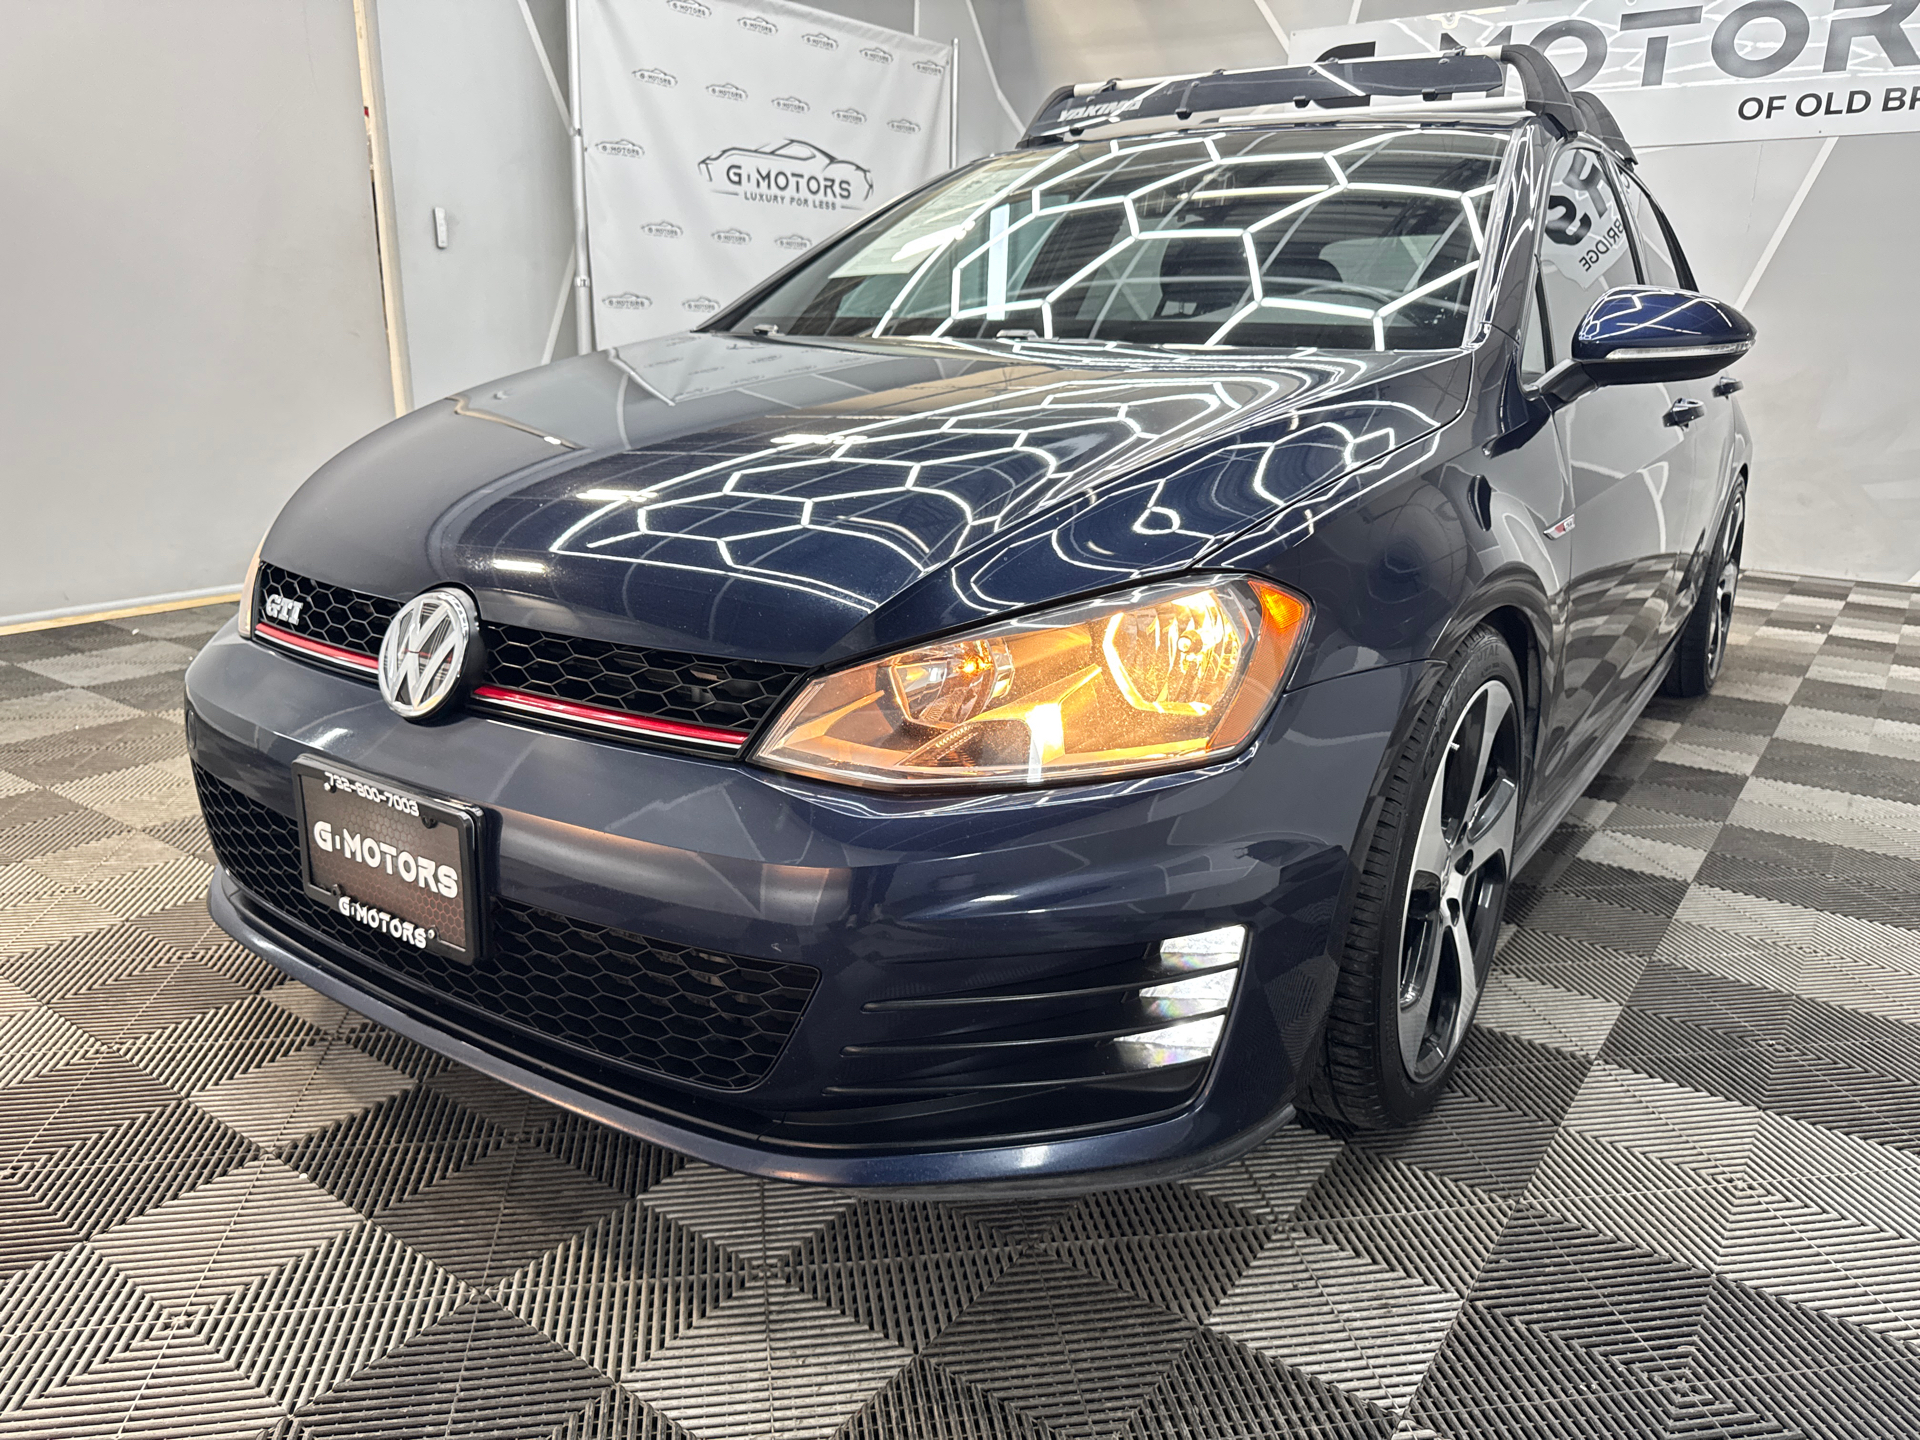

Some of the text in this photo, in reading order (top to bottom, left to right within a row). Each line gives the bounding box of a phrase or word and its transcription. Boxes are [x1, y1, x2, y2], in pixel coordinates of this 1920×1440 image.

[1056, 98, 1143, 122] YAKIMA
[1738, 95, 1787, 121] OF
[1795, 89, 1872, 118] OLD
[744, 190, 837, 210] LUXURY FOR LESS
[265, 593, 304, 626] GTI
[324, 771, 420, 817] 732-800-7003
